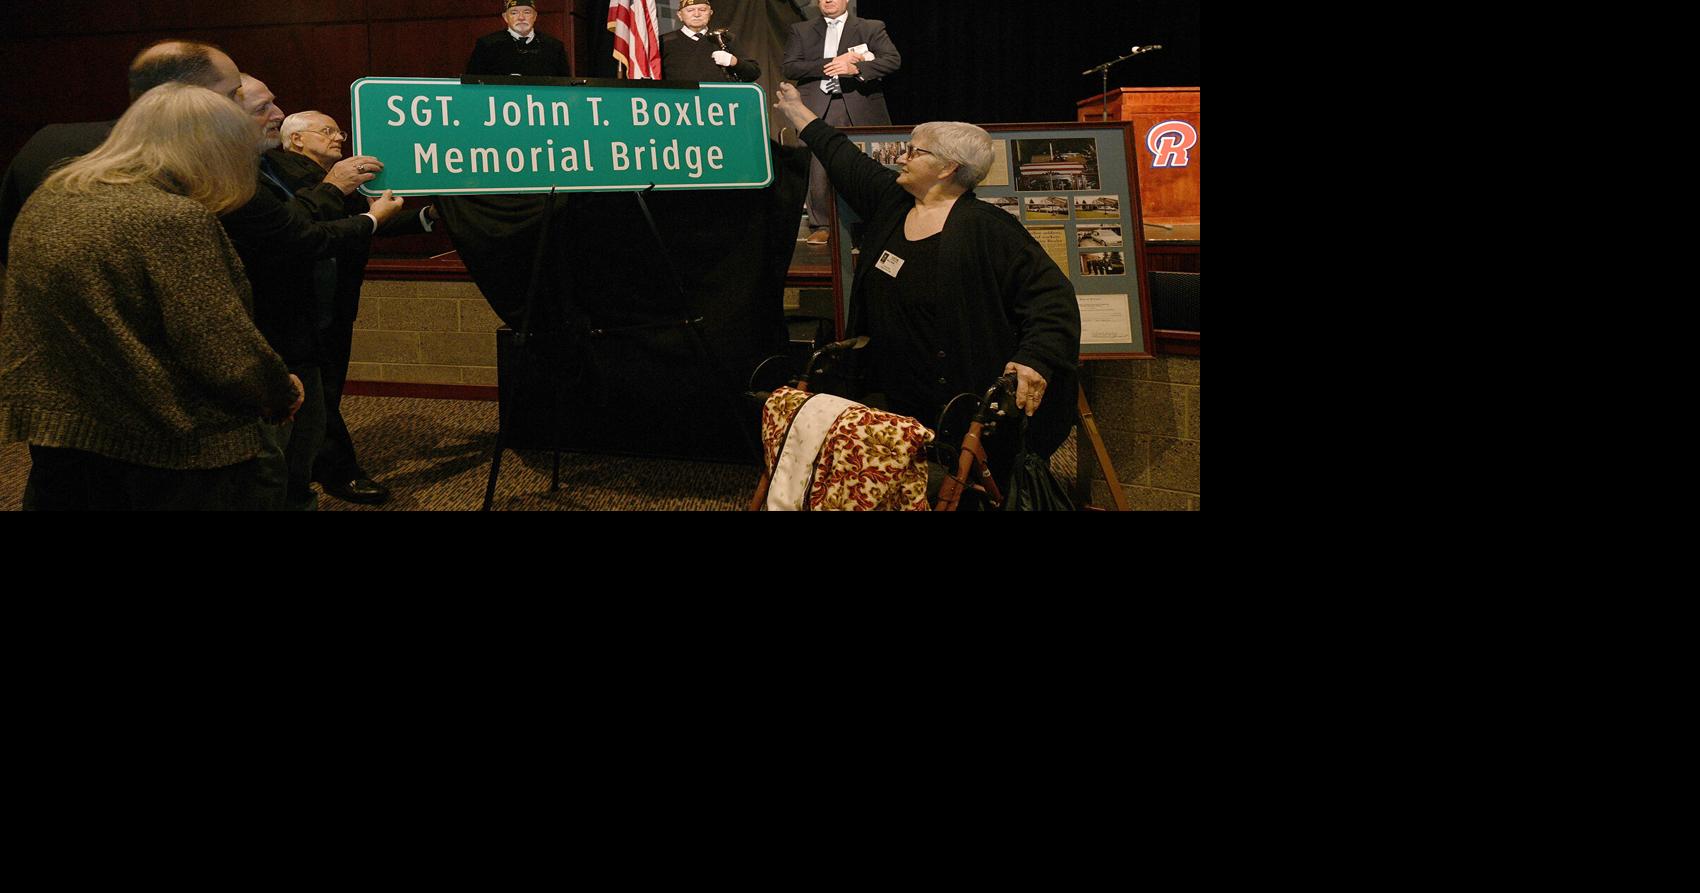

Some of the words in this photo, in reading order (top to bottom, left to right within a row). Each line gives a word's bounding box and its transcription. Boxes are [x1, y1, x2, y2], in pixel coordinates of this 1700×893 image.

[387, 95, 461, 127] SGT.
[484, 94, 570, 127] John
[586, 97, 610, 127] T.
[631, 95, 740, 127] Boxler
[414, 138, 594, 174] Memorial
[612, 138, 724, 179] Bridge
[1146, 120, 1198, 168] R
